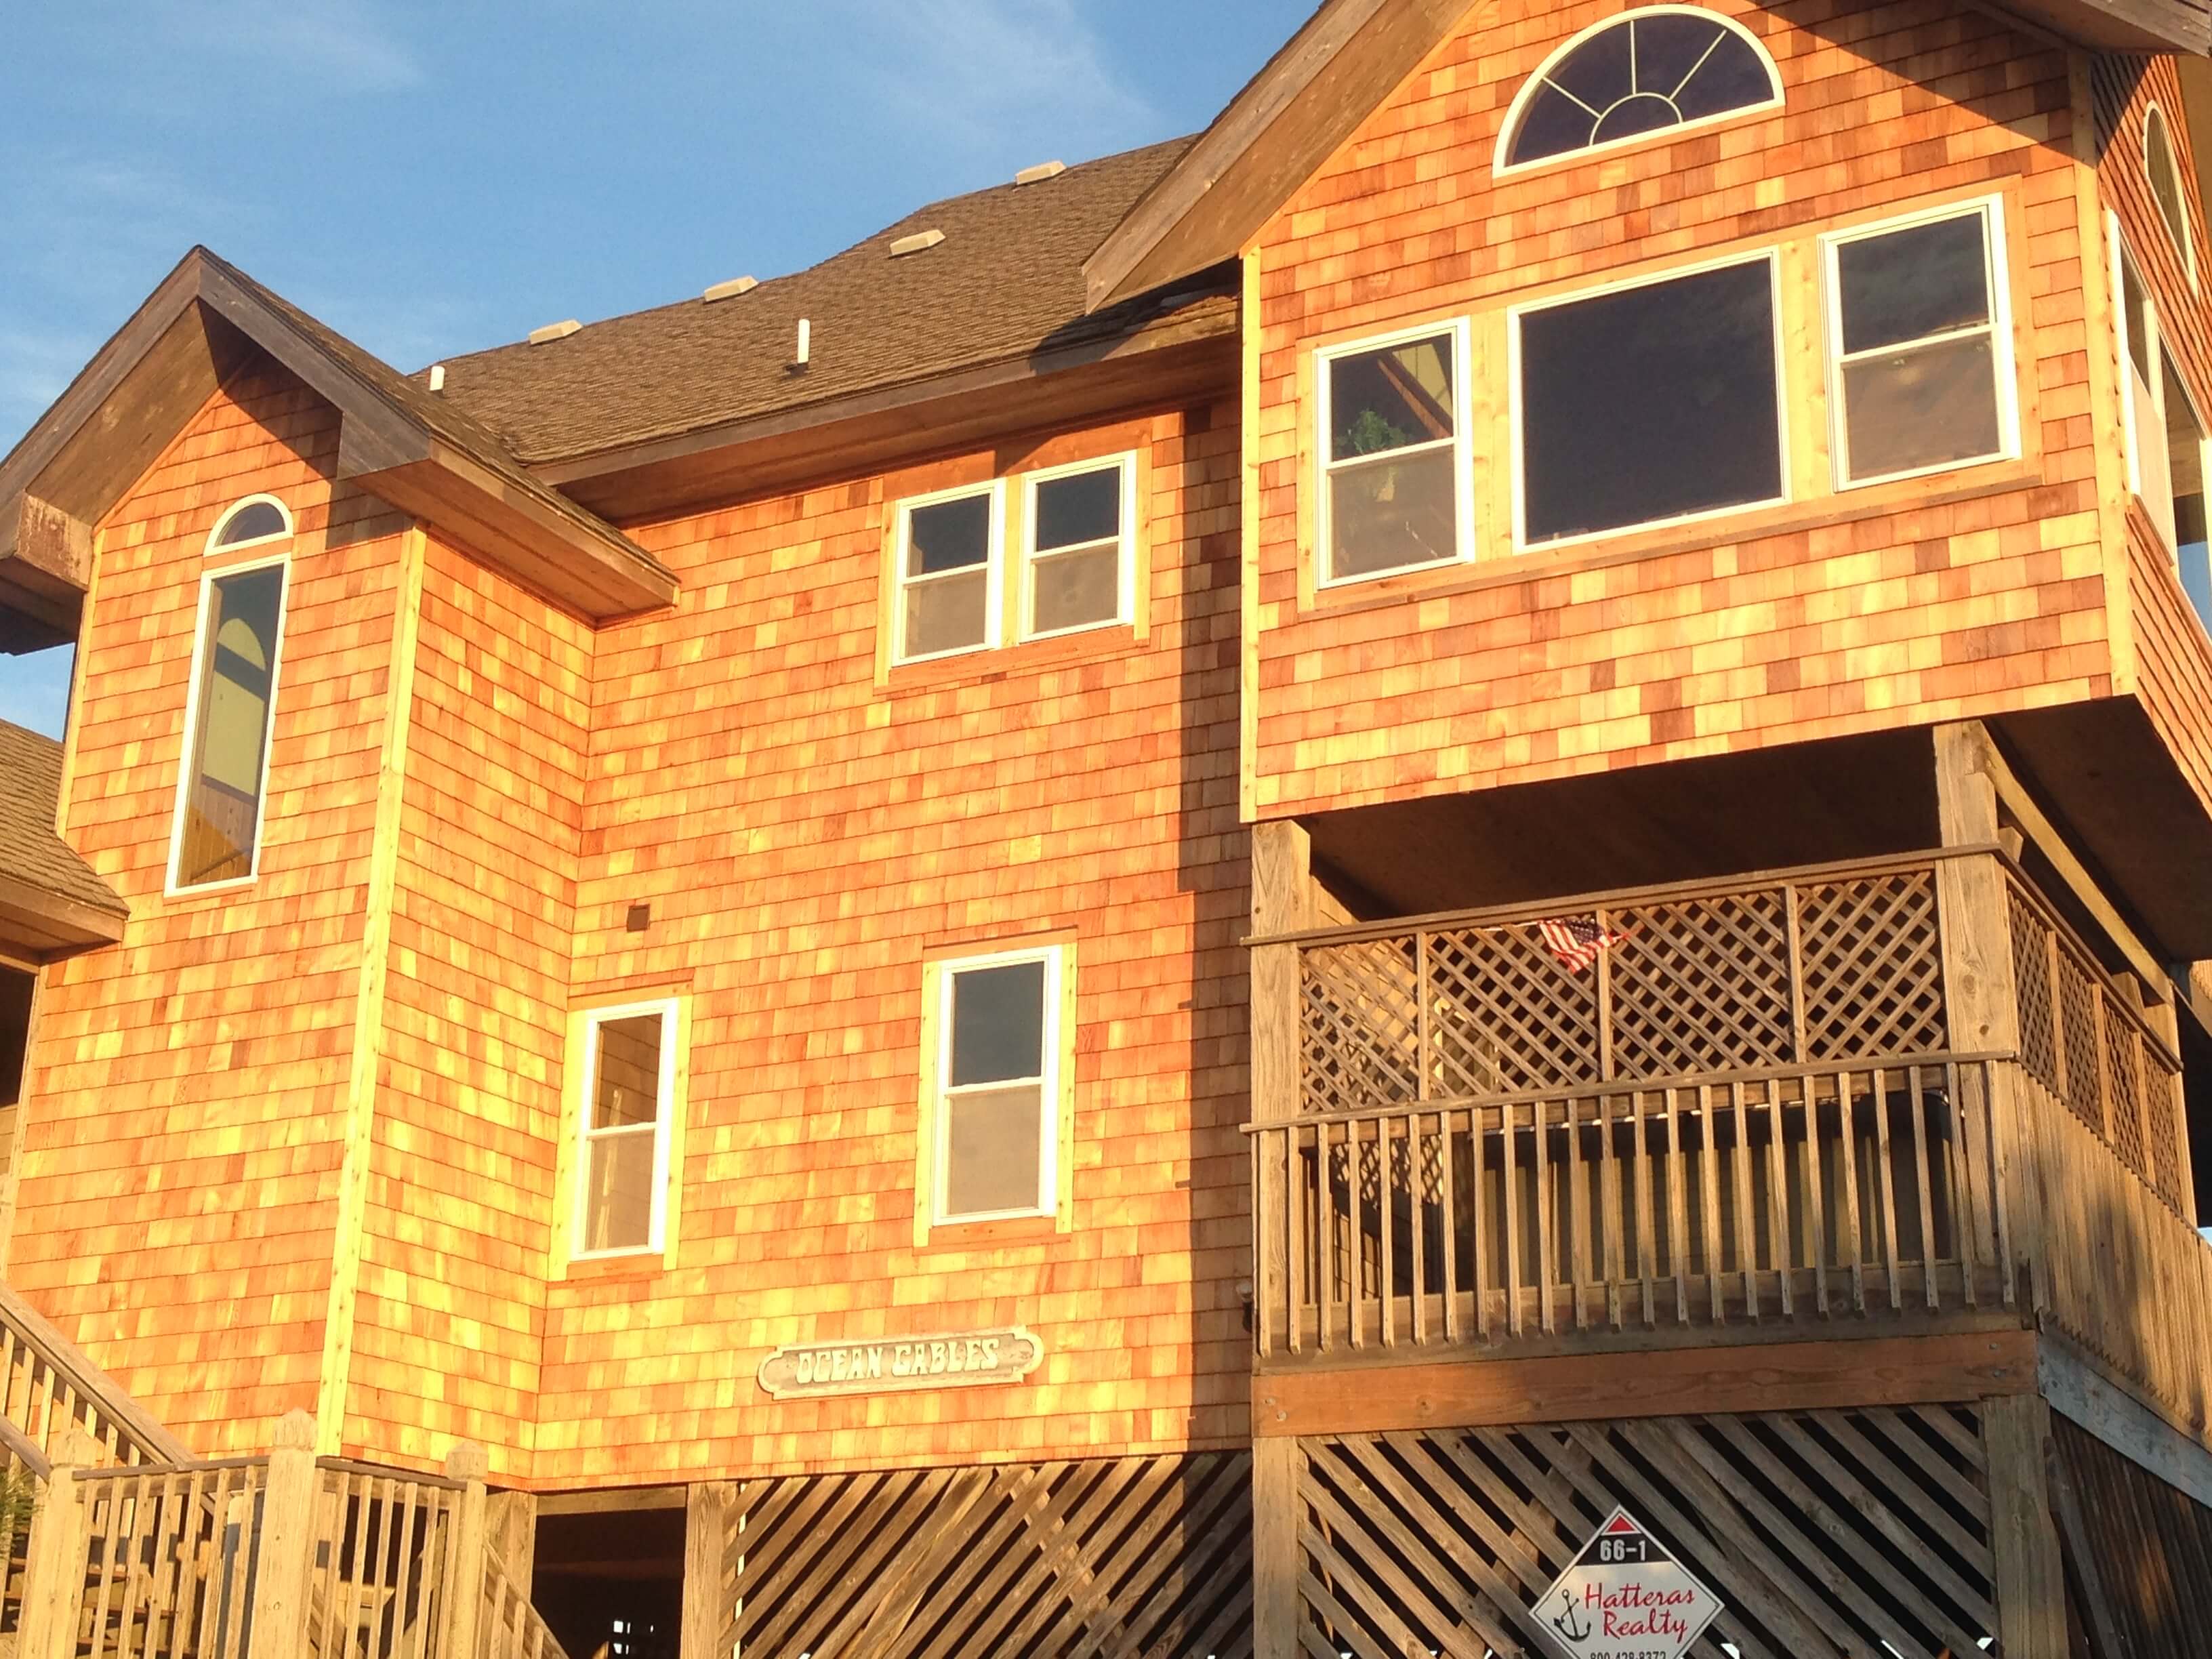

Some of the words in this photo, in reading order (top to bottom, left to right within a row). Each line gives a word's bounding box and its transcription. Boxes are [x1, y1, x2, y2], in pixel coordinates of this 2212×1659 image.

[796, 1347, 883, 1384] OCEAN
[891, 1338, 1000, 1376] GABLES
[1600, 1539, 1646, 1561] 66-1
[1585, 1582, 1695, 1610] Hatteras
[1603, 1608, 1687, 1643] Realty
